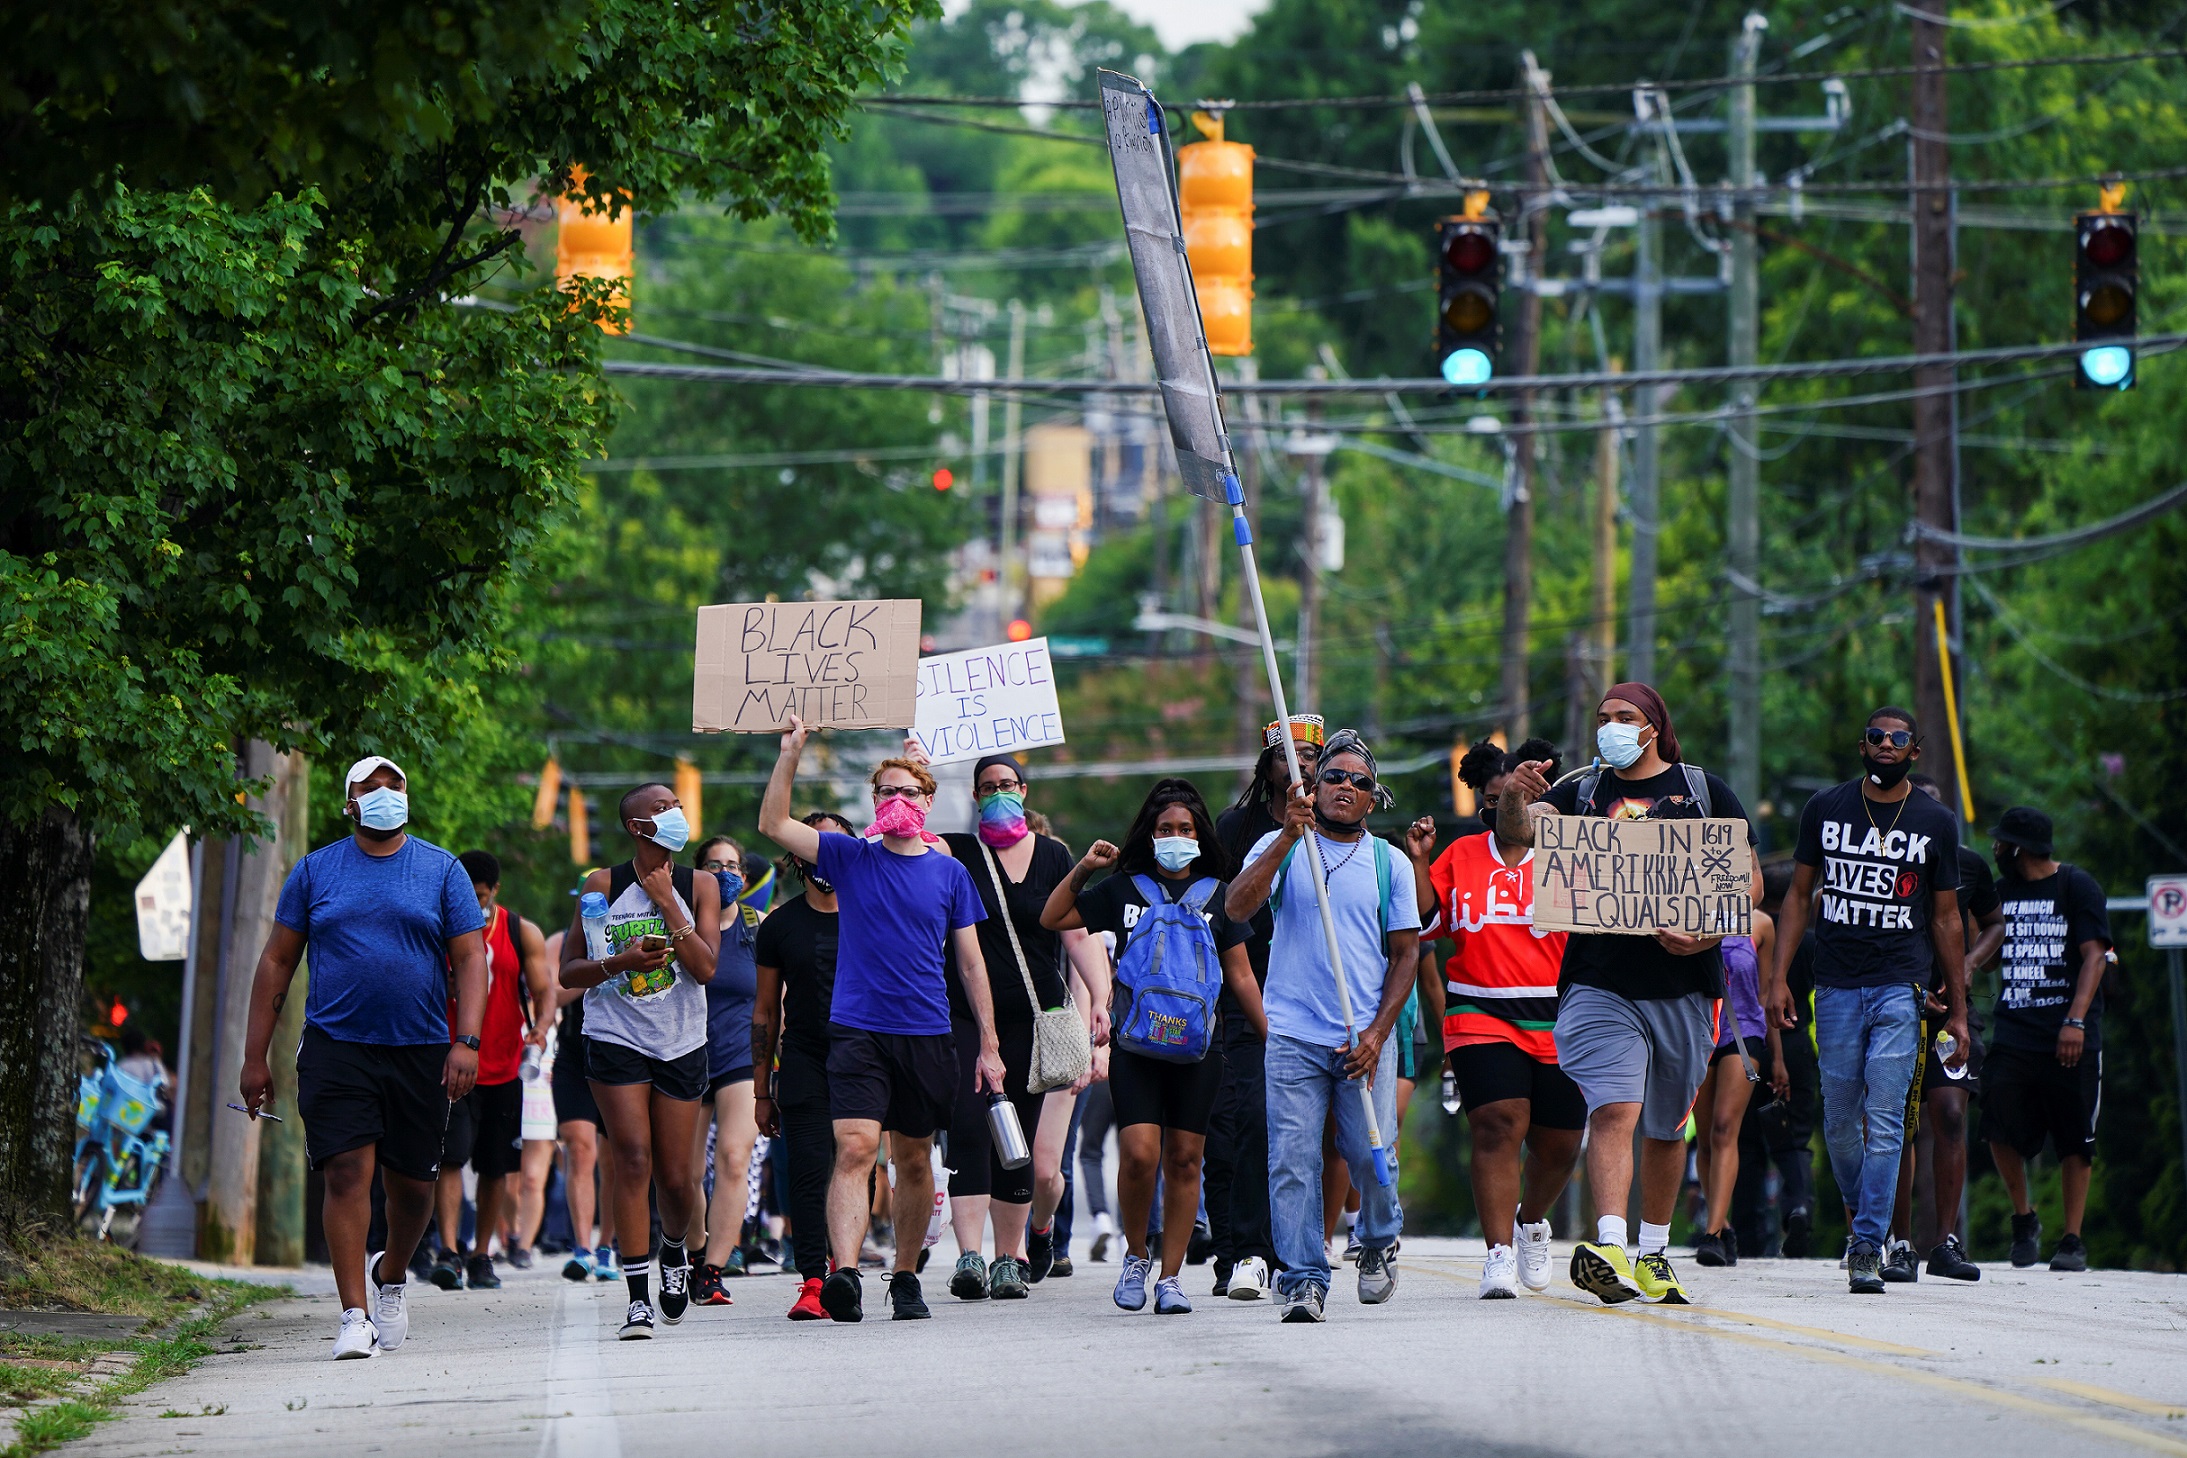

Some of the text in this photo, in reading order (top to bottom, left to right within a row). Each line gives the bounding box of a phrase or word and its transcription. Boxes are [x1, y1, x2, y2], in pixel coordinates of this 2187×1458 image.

[741, 605, 879, 653] BLACK
[745, 651, 863, 685] LIVES
[734, 684, 868, 725] MATTER
[956, 694, 988, 719] IS
[916, 713, 1062, 757] VIOLENCE
[1540, 816, 1692, 854] BLACK IN
[1702, 822, 1732, 846] 1619
[1822, 820, 1931, 864] BLACK
[1710, 847, 1722, 855] to
[1541, 851, 1700, 896] AMERIKKKA
[1715, 882, 1733, 891] NOW
[612, 912, 635, 920] TEENAGE
[1570, 889, 1680, 929] EQUALS
[1684, 894, 1752, 935] DEATH
[1822, 894, 1913, 929] MATTER
[2018, 900, 2054, 915] MARCH
[611, 919, 669, 947] TURTL
[2016, 922, 2033, 936] SIT
[2033, 923, 2068, 937] DOWN
[2015, 944, 2048, 958] SPEAK
[2050, 944, 2065, 958] UP
[2013, 966, 2046, 980] KNEEL
[2008, 995, 2068, 1009] Silnce.
[1148, 1010, 1188, 1028] THANKS
